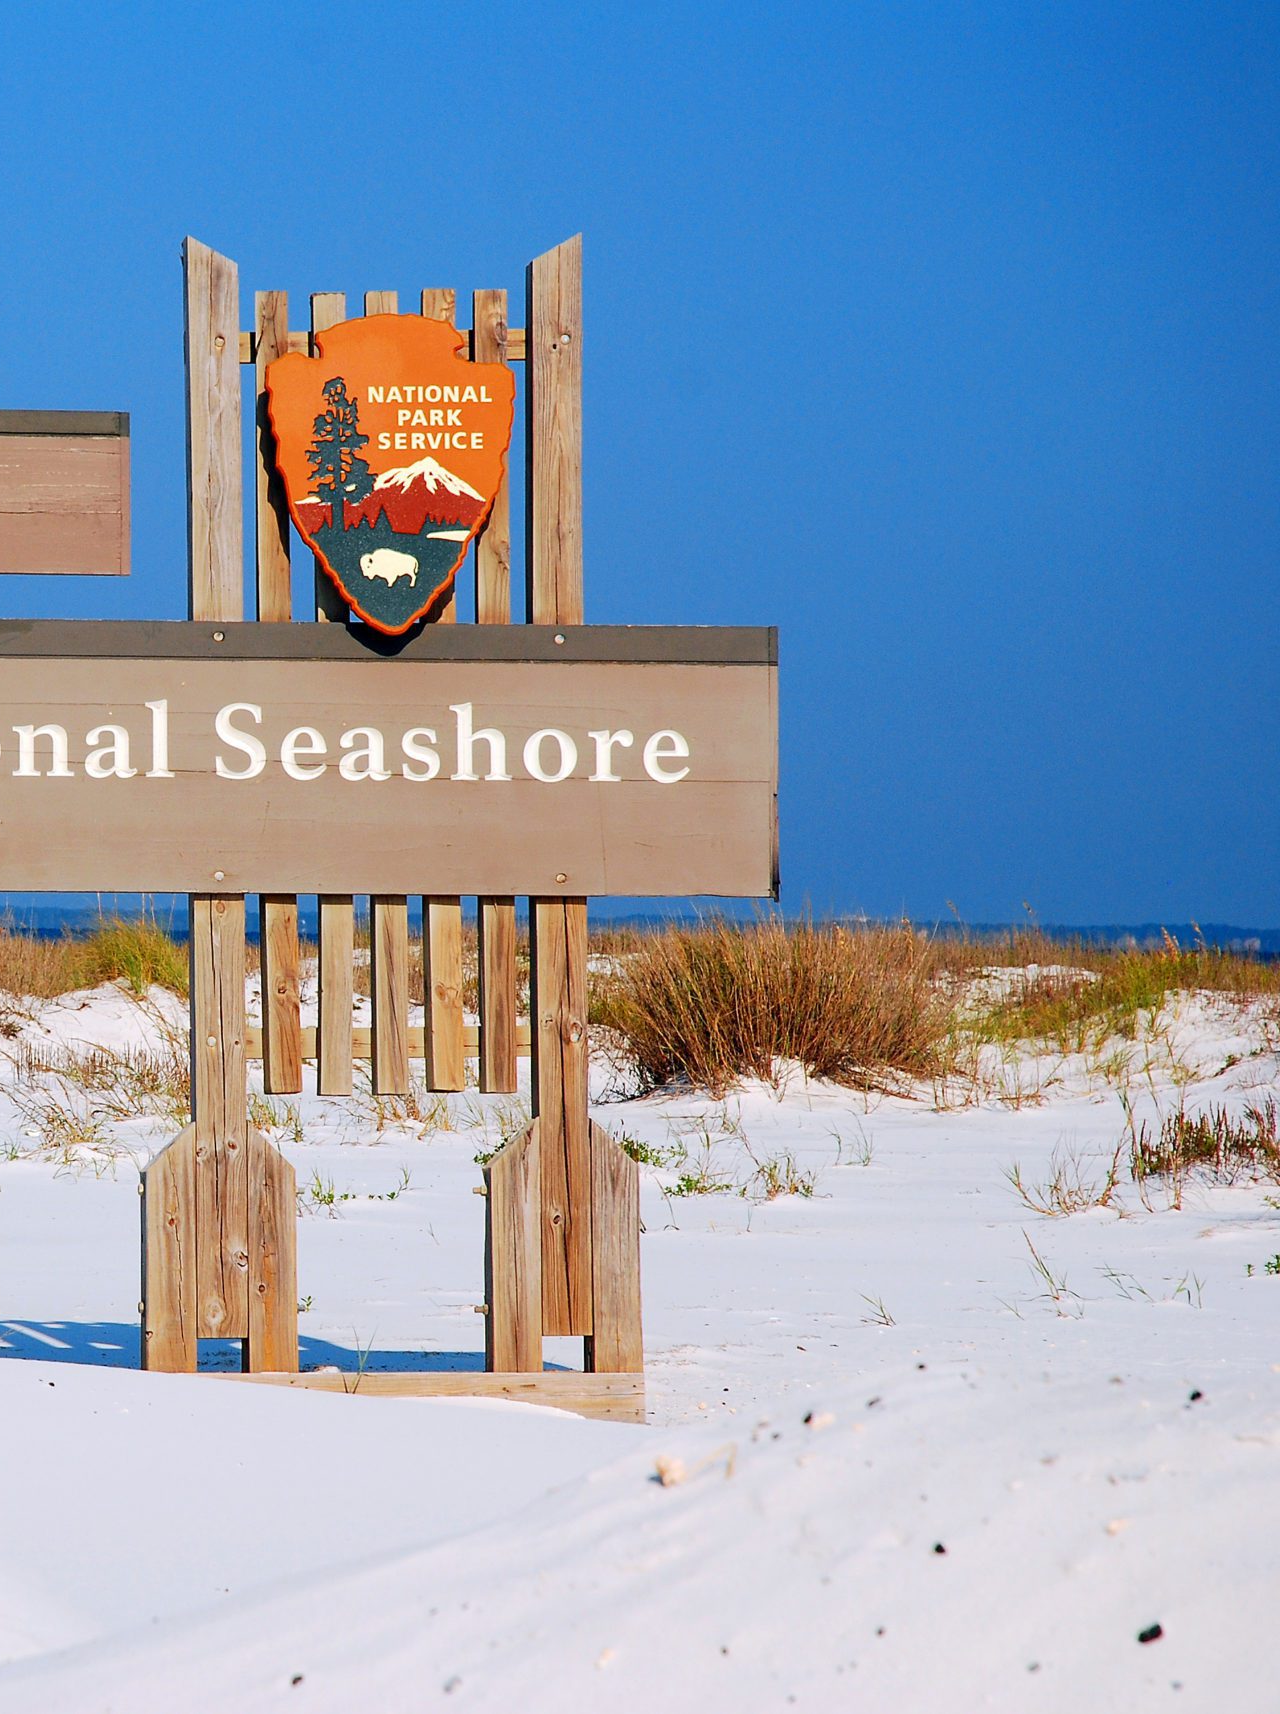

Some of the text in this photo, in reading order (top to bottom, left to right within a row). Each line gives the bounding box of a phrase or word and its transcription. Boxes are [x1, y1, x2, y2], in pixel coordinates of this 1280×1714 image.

[368, 385, 492, 403] NATIONAL
[398, 409, 462, 426] PARK
[378, 432, 484, 449] SERVICE
[214, 702, 690, 784] Seashore
